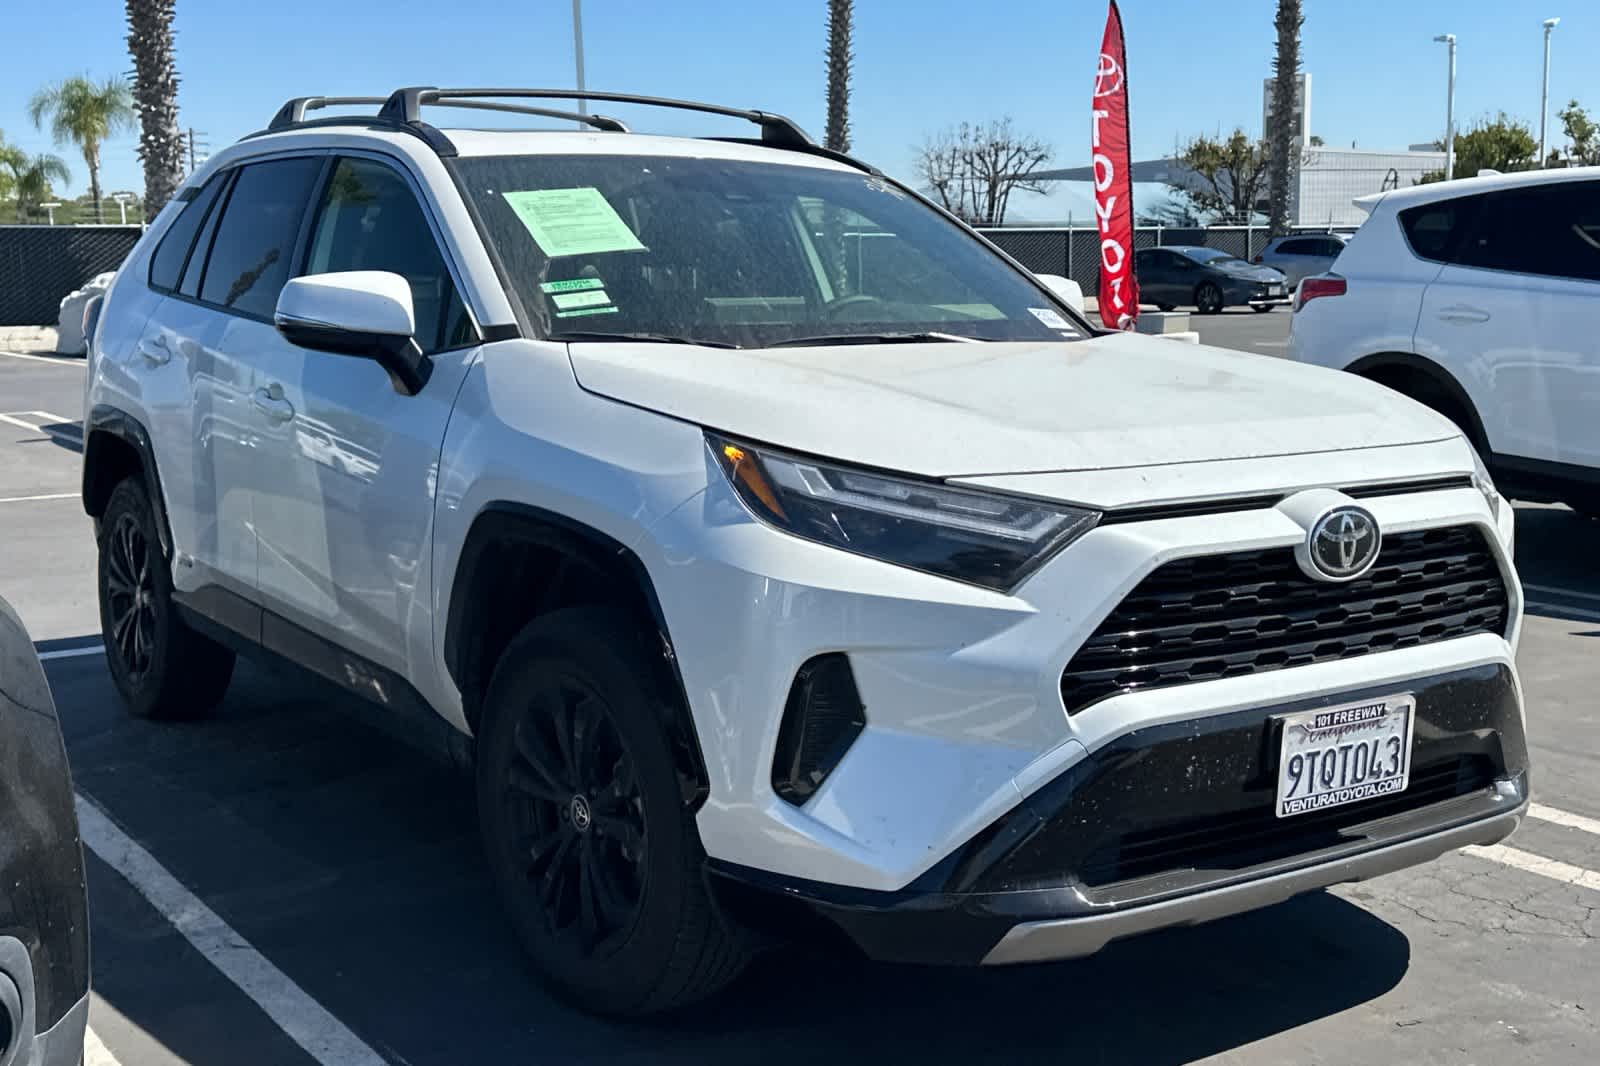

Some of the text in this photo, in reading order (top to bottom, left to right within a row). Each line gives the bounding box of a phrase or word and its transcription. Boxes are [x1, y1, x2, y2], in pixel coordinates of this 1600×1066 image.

[1317, 705, 1383, 728] 101 FREEWAY
[1286, 735, 1400, 798] 9TQT043
[1284, 779, 1401, 813] VENTURATOYOTA.COM
